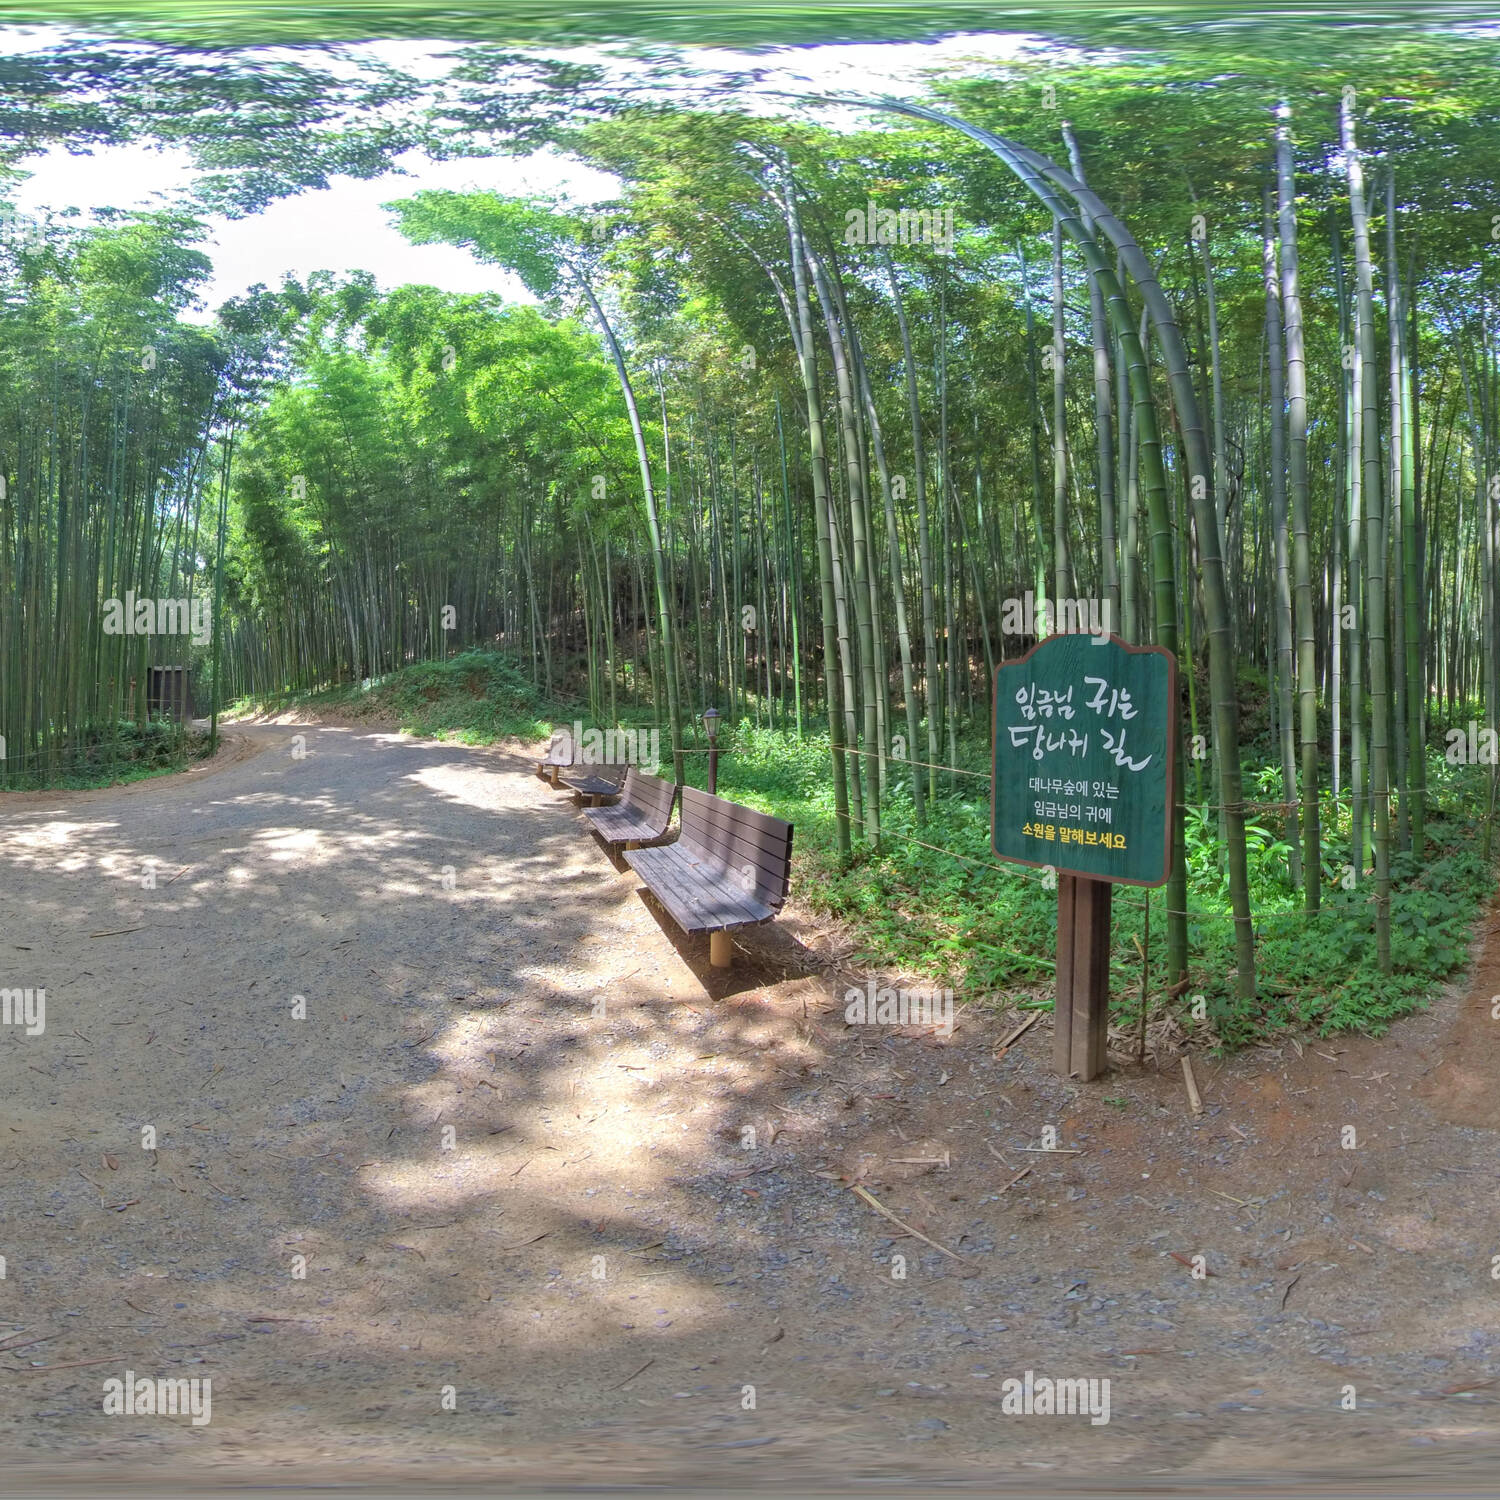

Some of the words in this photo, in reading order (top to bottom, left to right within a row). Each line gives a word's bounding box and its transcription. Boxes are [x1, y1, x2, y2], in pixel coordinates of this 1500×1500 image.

[1016, 683, 1075, 720] 임금님
[1085, 677, 1139, 720] 귀는
[1009, 726, 1088, 760] 당나귀
[1101, 729, 1152, 771] 길
[1029, 777, 1089, 797] 대나무숲에
[1093, 781, 1120, 799] 있는
[1033, 802, 1081, 820] 임금님의
[1085, 806, 1112, 824] 귀에
[1022, 823, 1055, 841] 소원을
[1059, 828, 1127, 849] 말해보세요
